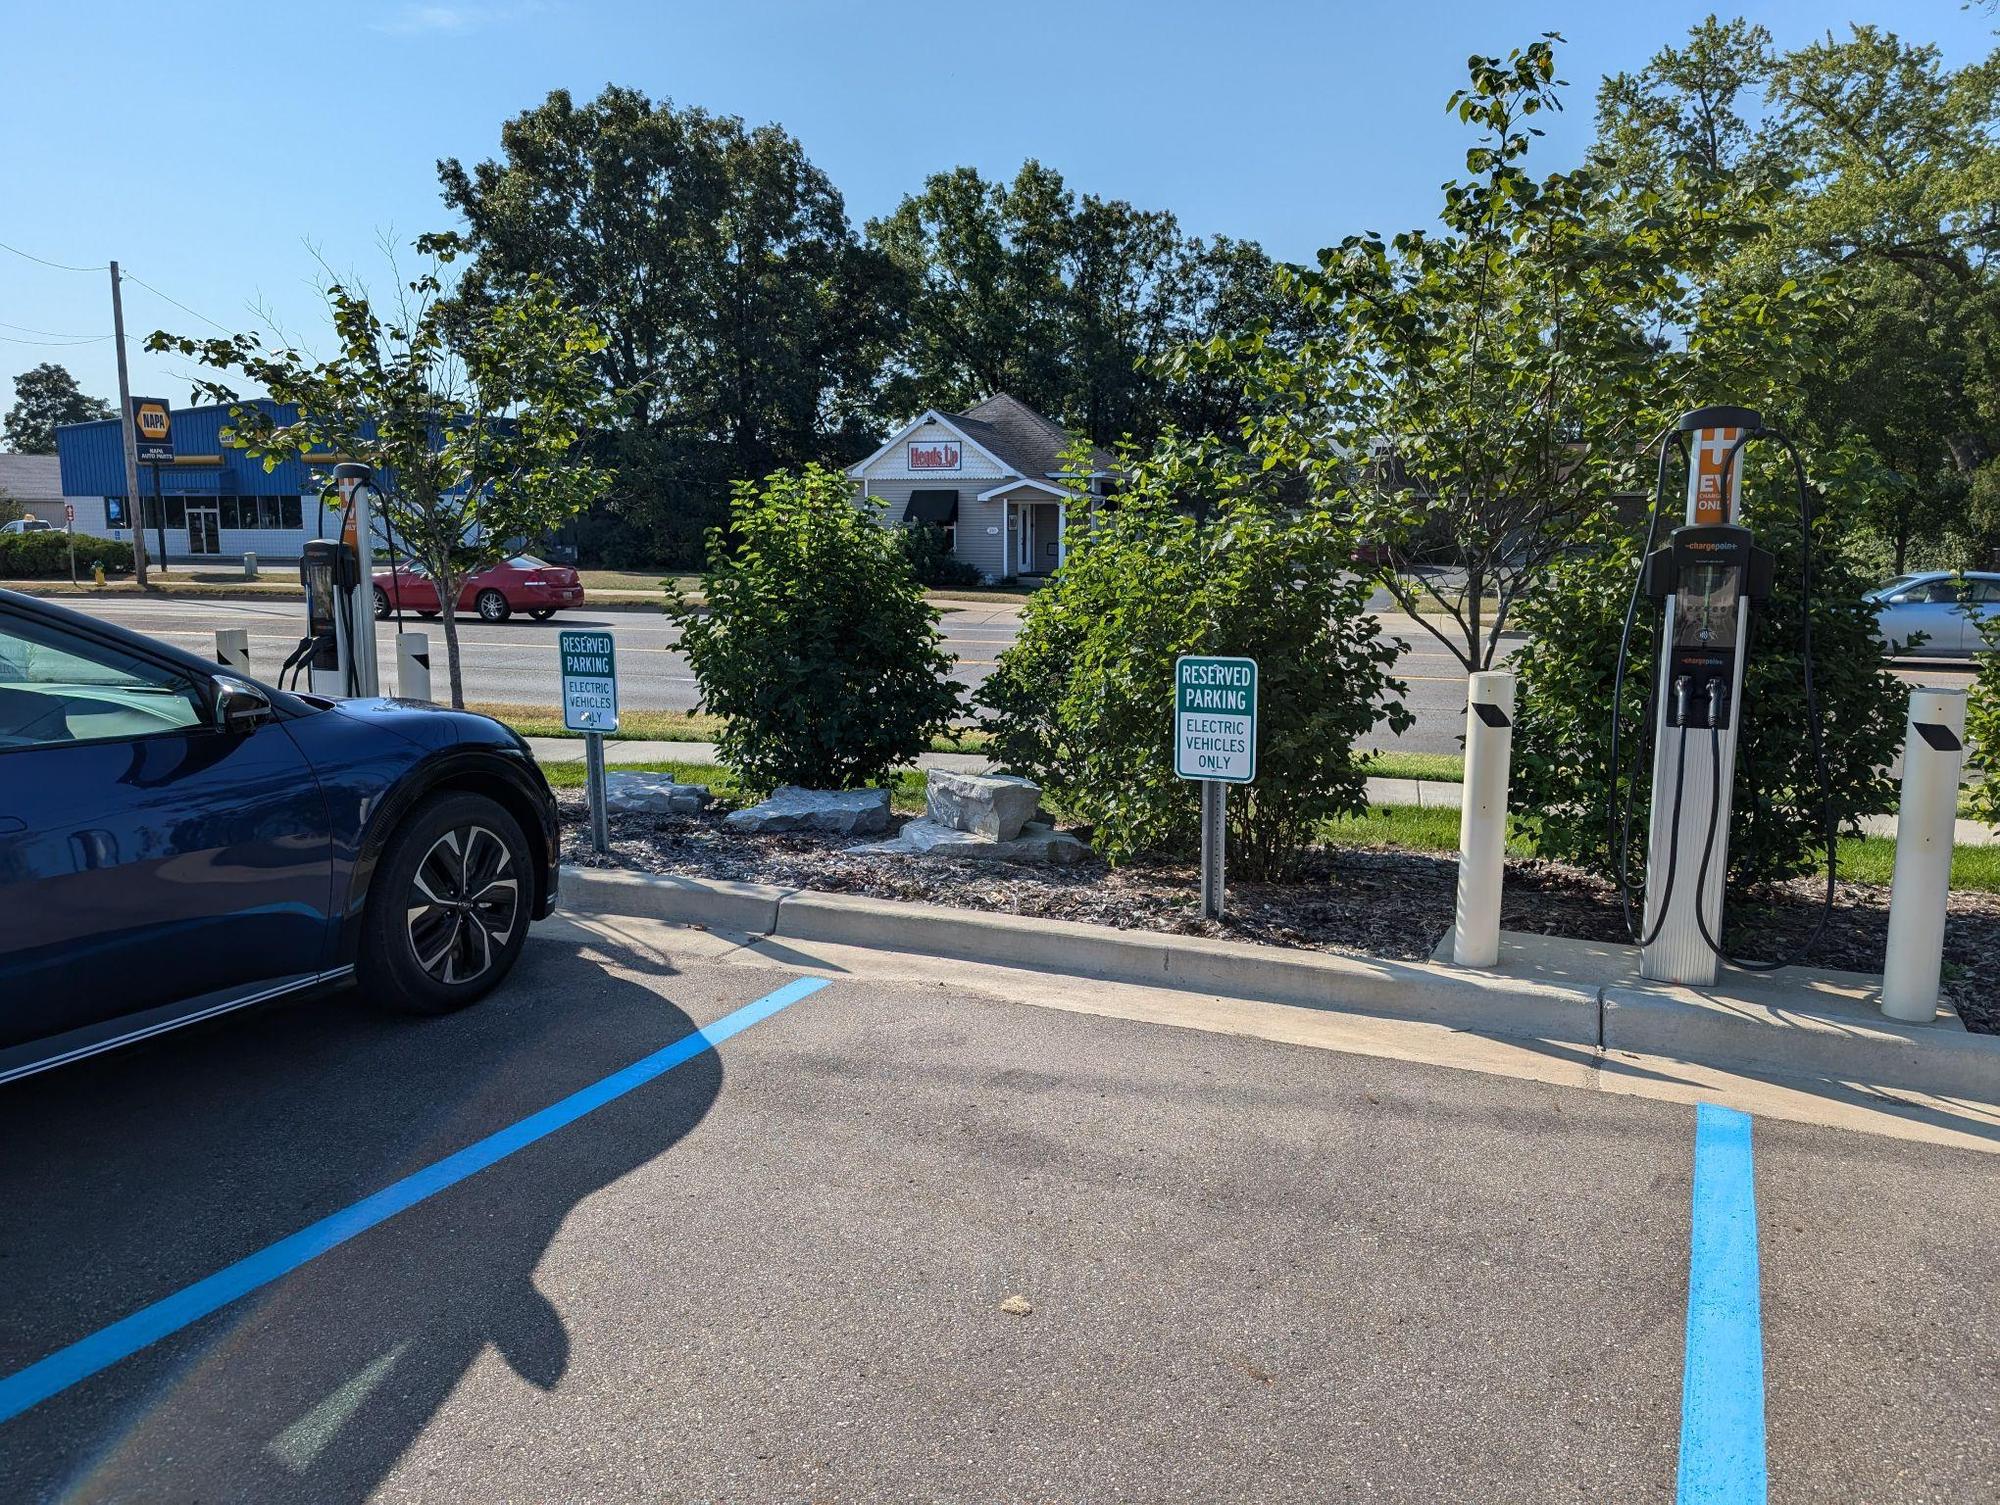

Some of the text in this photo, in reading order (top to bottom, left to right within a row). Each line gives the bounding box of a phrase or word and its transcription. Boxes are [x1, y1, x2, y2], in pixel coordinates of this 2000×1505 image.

[143, 413, 165, 429] NAPA
[911, 447, 942, 465] Heads
[1699, 474, 1732, 493] EV
[1698, 500, 1730, 511] ONL
[563, 637, 610, 653] RESERVED
[567, 656, 609, 673] PARKING
[1182, 665, 1250, 686] RESERVED
[569, 681, 610, 694] ELECTRIC
[570, 696, 612, 709] VEHICLES
[1186, 688, 1246, 709] PARKING
[1186, 719, 1244, 735] ELECTRIC
[1186, 736, 1245, 753] VEHICLES
[1198, 755, 1231, 770] ONLY
